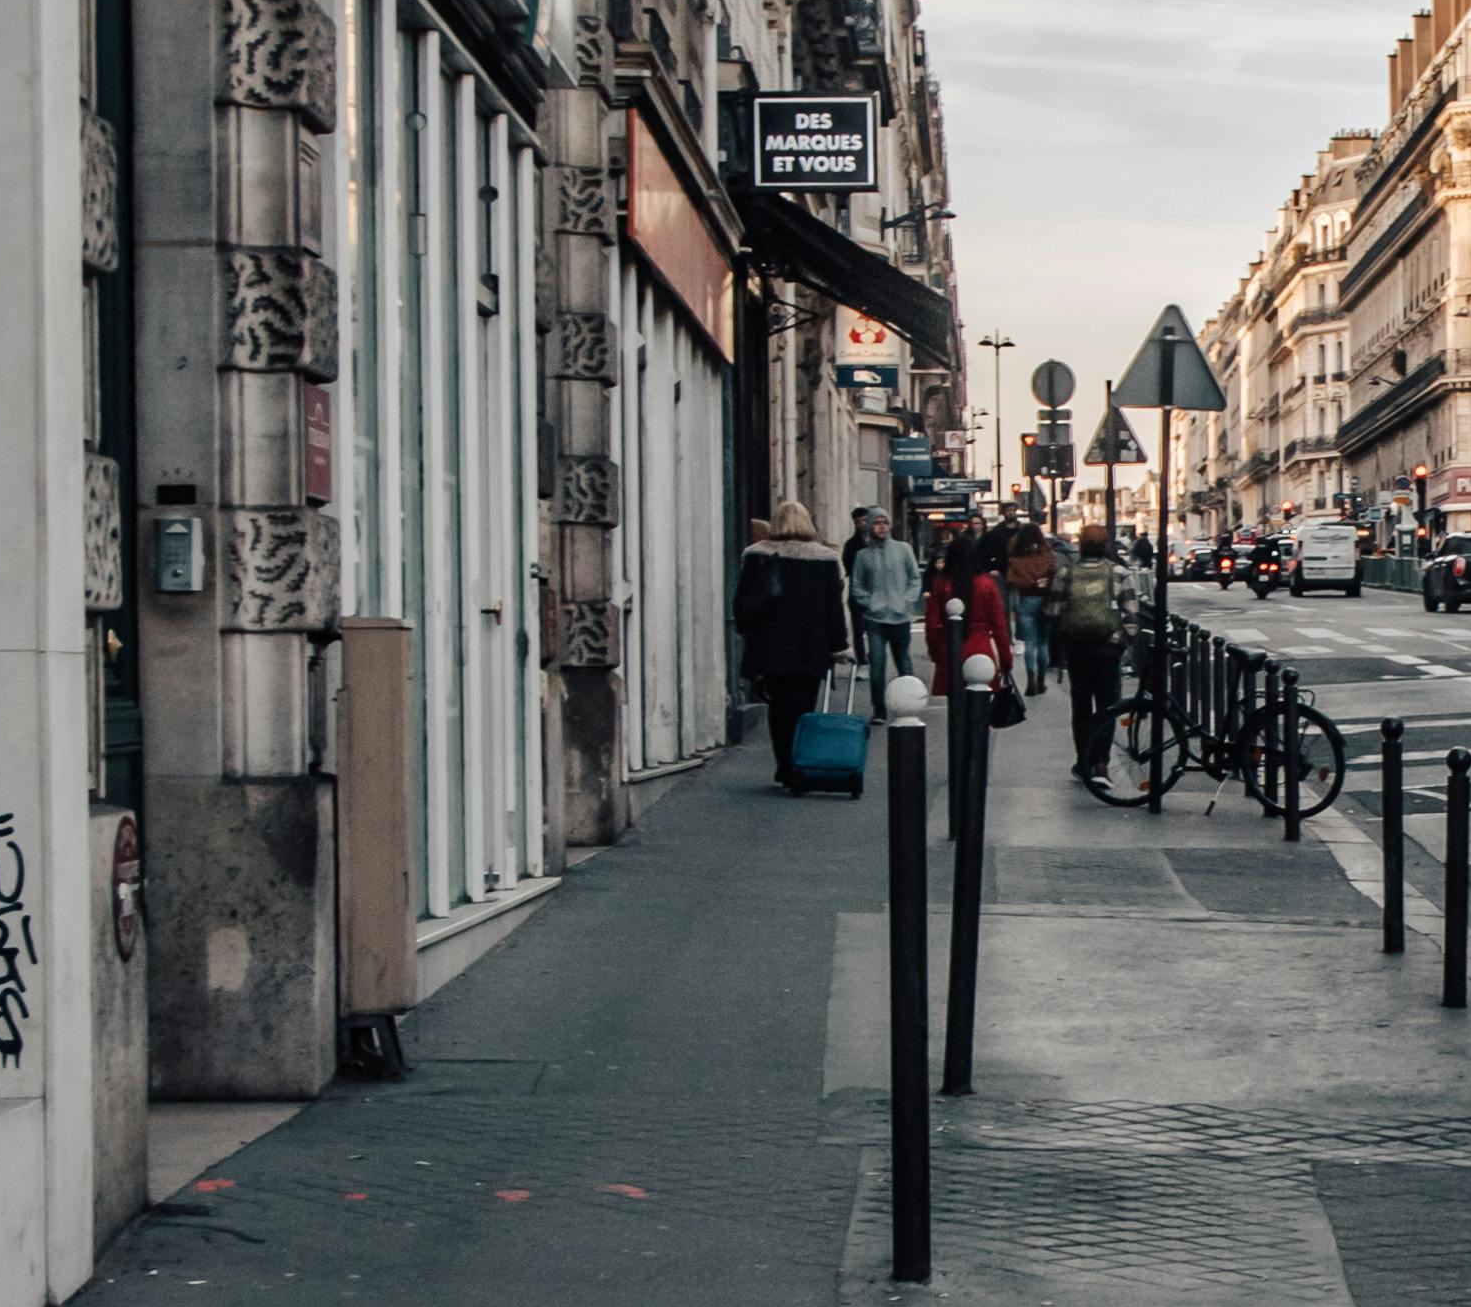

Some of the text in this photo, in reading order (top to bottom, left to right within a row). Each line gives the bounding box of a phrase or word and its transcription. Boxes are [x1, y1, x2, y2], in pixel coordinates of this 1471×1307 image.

[795, 113, 832, 130] DES
[765, 135, 863, 151] MARQUES
[772, 156, 856, 173] ET VOUS
